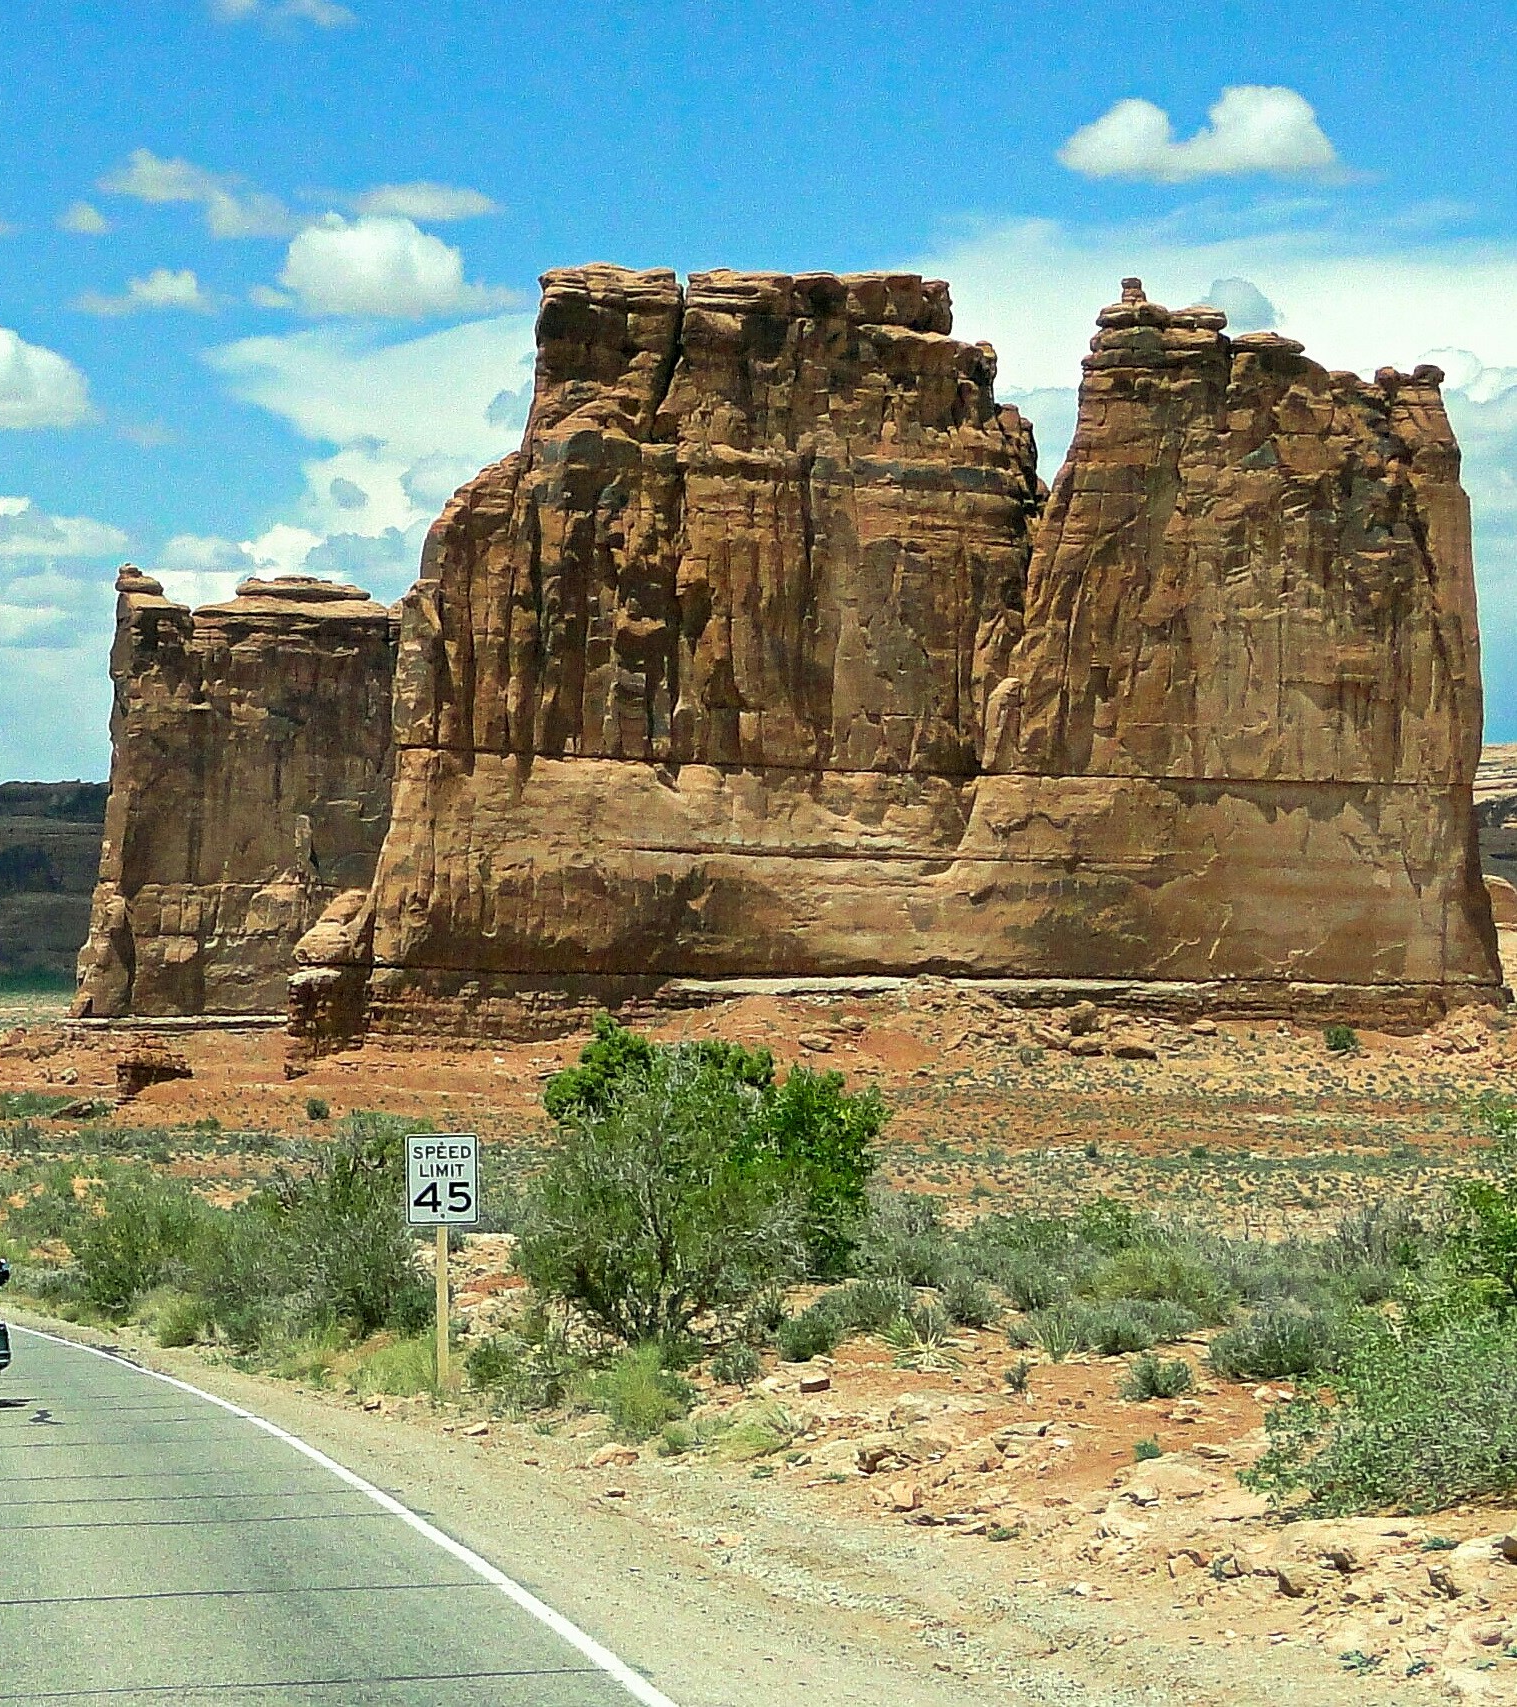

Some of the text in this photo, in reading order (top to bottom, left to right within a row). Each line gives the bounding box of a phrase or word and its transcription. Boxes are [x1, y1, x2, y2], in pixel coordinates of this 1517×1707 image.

[413, 1145, 472, 1159] SPEED
[419, 1164, 465, 1178] LIMIT
[413, 1182, 472, 1213] 45
